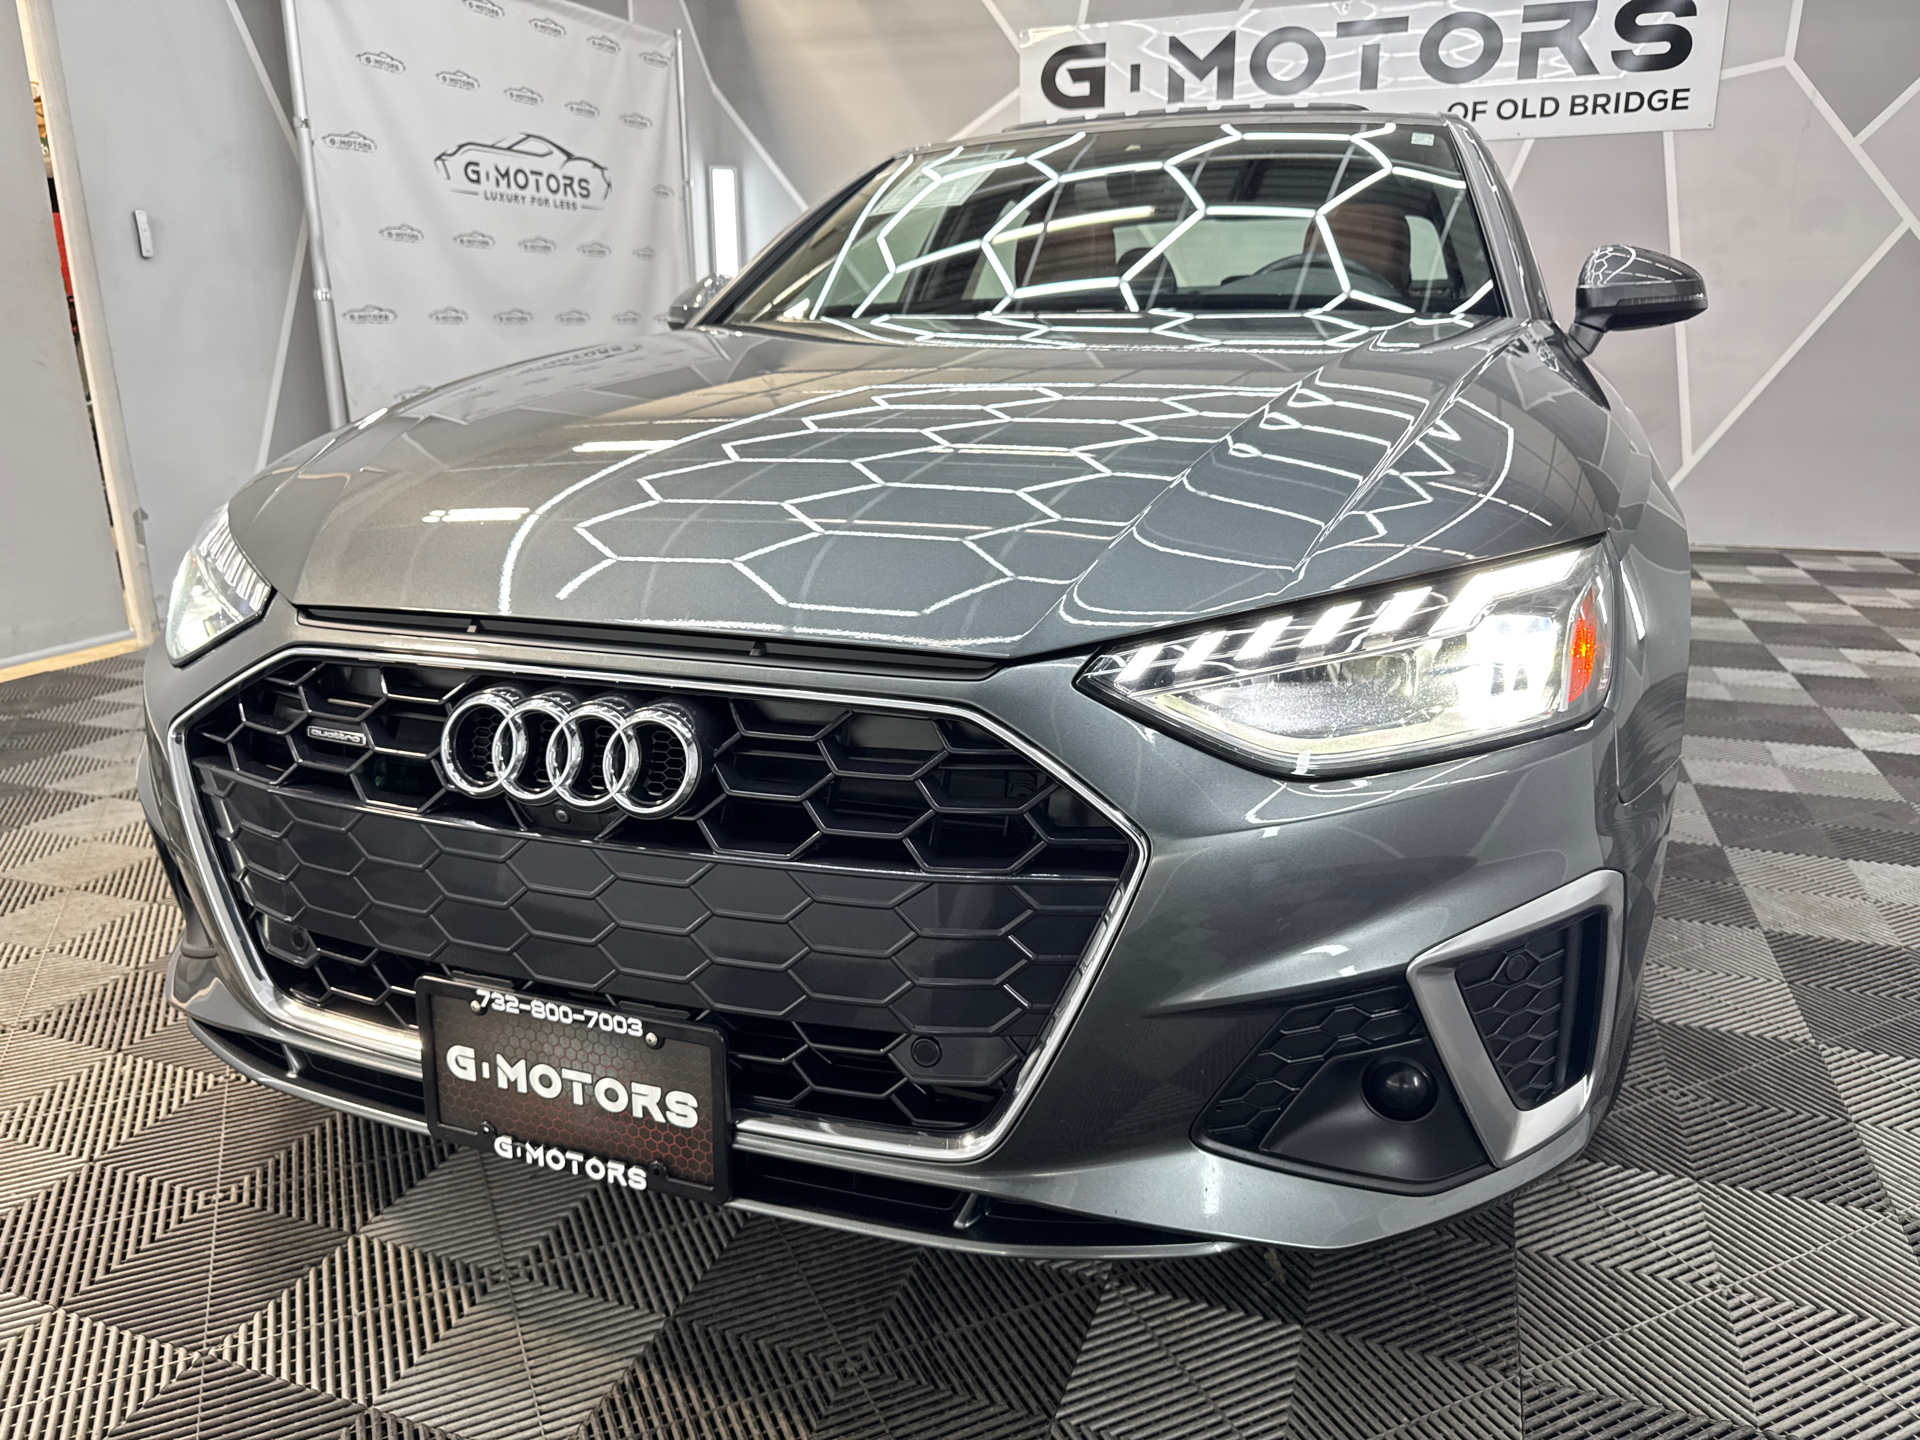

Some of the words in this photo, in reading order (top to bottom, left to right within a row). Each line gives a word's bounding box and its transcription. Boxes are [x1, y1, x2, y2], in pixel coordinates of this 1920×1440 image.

[1447, 100, 1488, 123] OF
[1496, 97, 1560, 121] OLD
[1569, 88, 1691, 117] BRIDGE
[483, 190, 526, 205] LUXURY
[530, 197, 550, 208] FOR
[553, 199, 578, 211] LESS
[310, 728, 361, 743] quattro
[475, 989, 643, 1037] 732-800-7003
